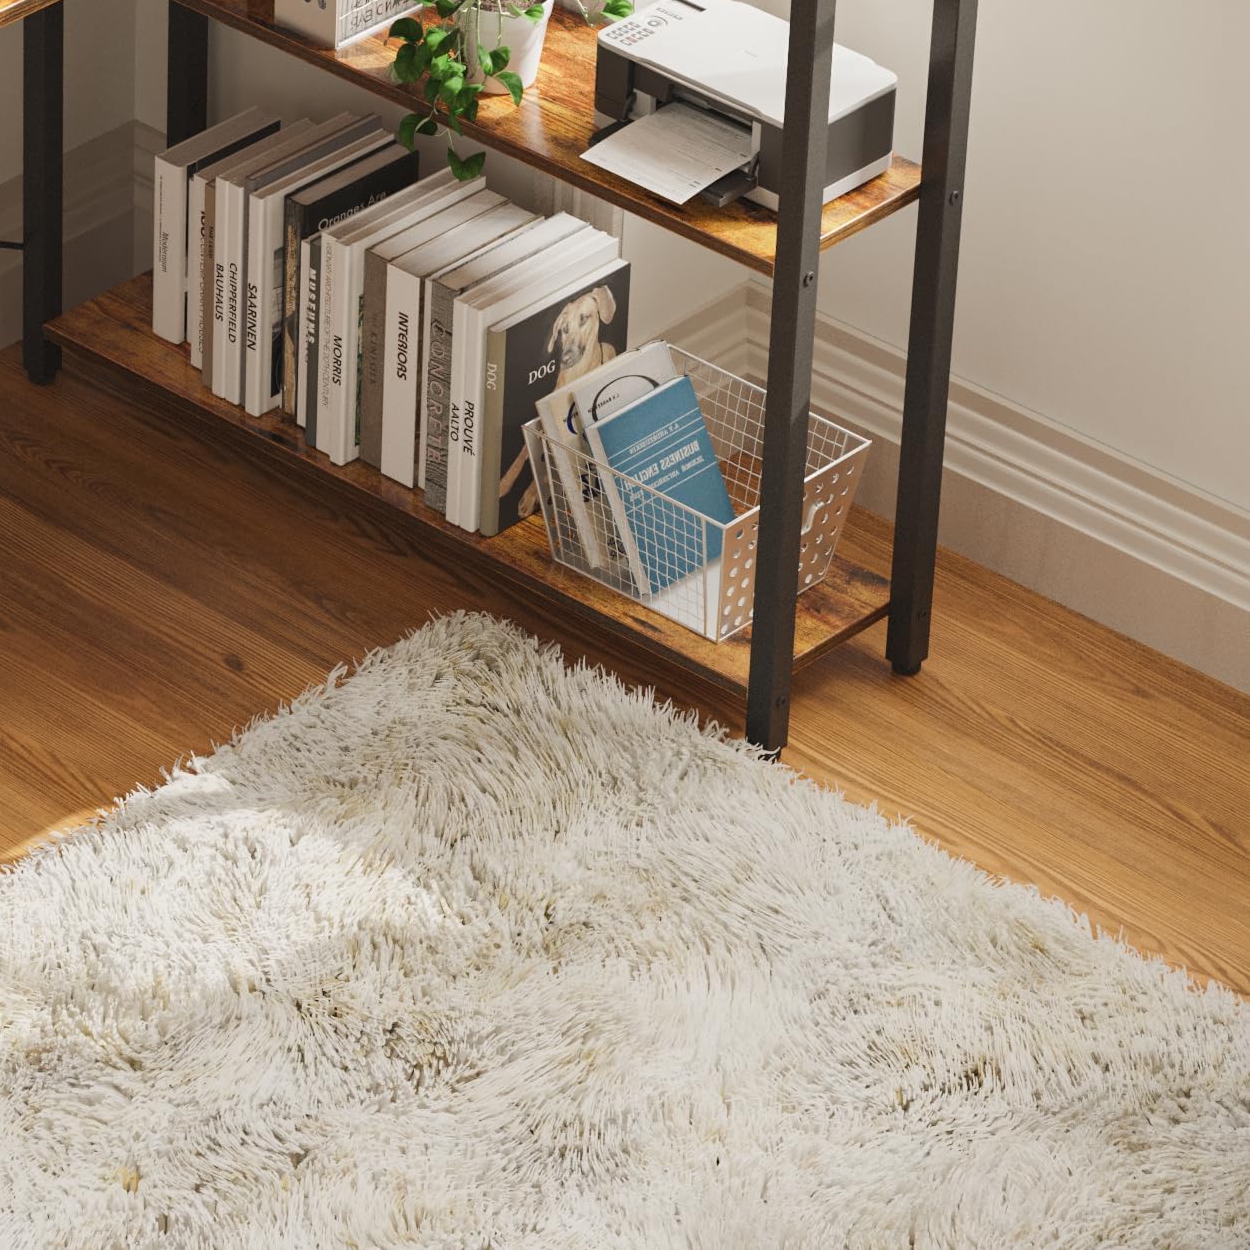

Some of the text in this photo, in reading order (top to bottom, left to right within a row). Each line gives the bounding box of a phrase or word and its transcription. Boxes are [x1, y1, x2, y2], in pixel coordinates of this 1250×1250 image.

[215, 263, 224, 322] BAUHAUS
[228, 262, 238, 343] CHIPPERFIELD
[247, 283, 258, 351] SAARINEN
[306, 267, 317, 345] MUSEUMS
[332, 335, 343, 386] MORRIS
[397, 311, 409, 381] INTERIORS
[527, 359, 556, 385] DOG
[426, 322, 445, 464] CONCRETE
[487, 362, 497, 391] DOG
[450, 402, 460, 442] AALTO
[463, 400, 476, 456] PROUVÉ
